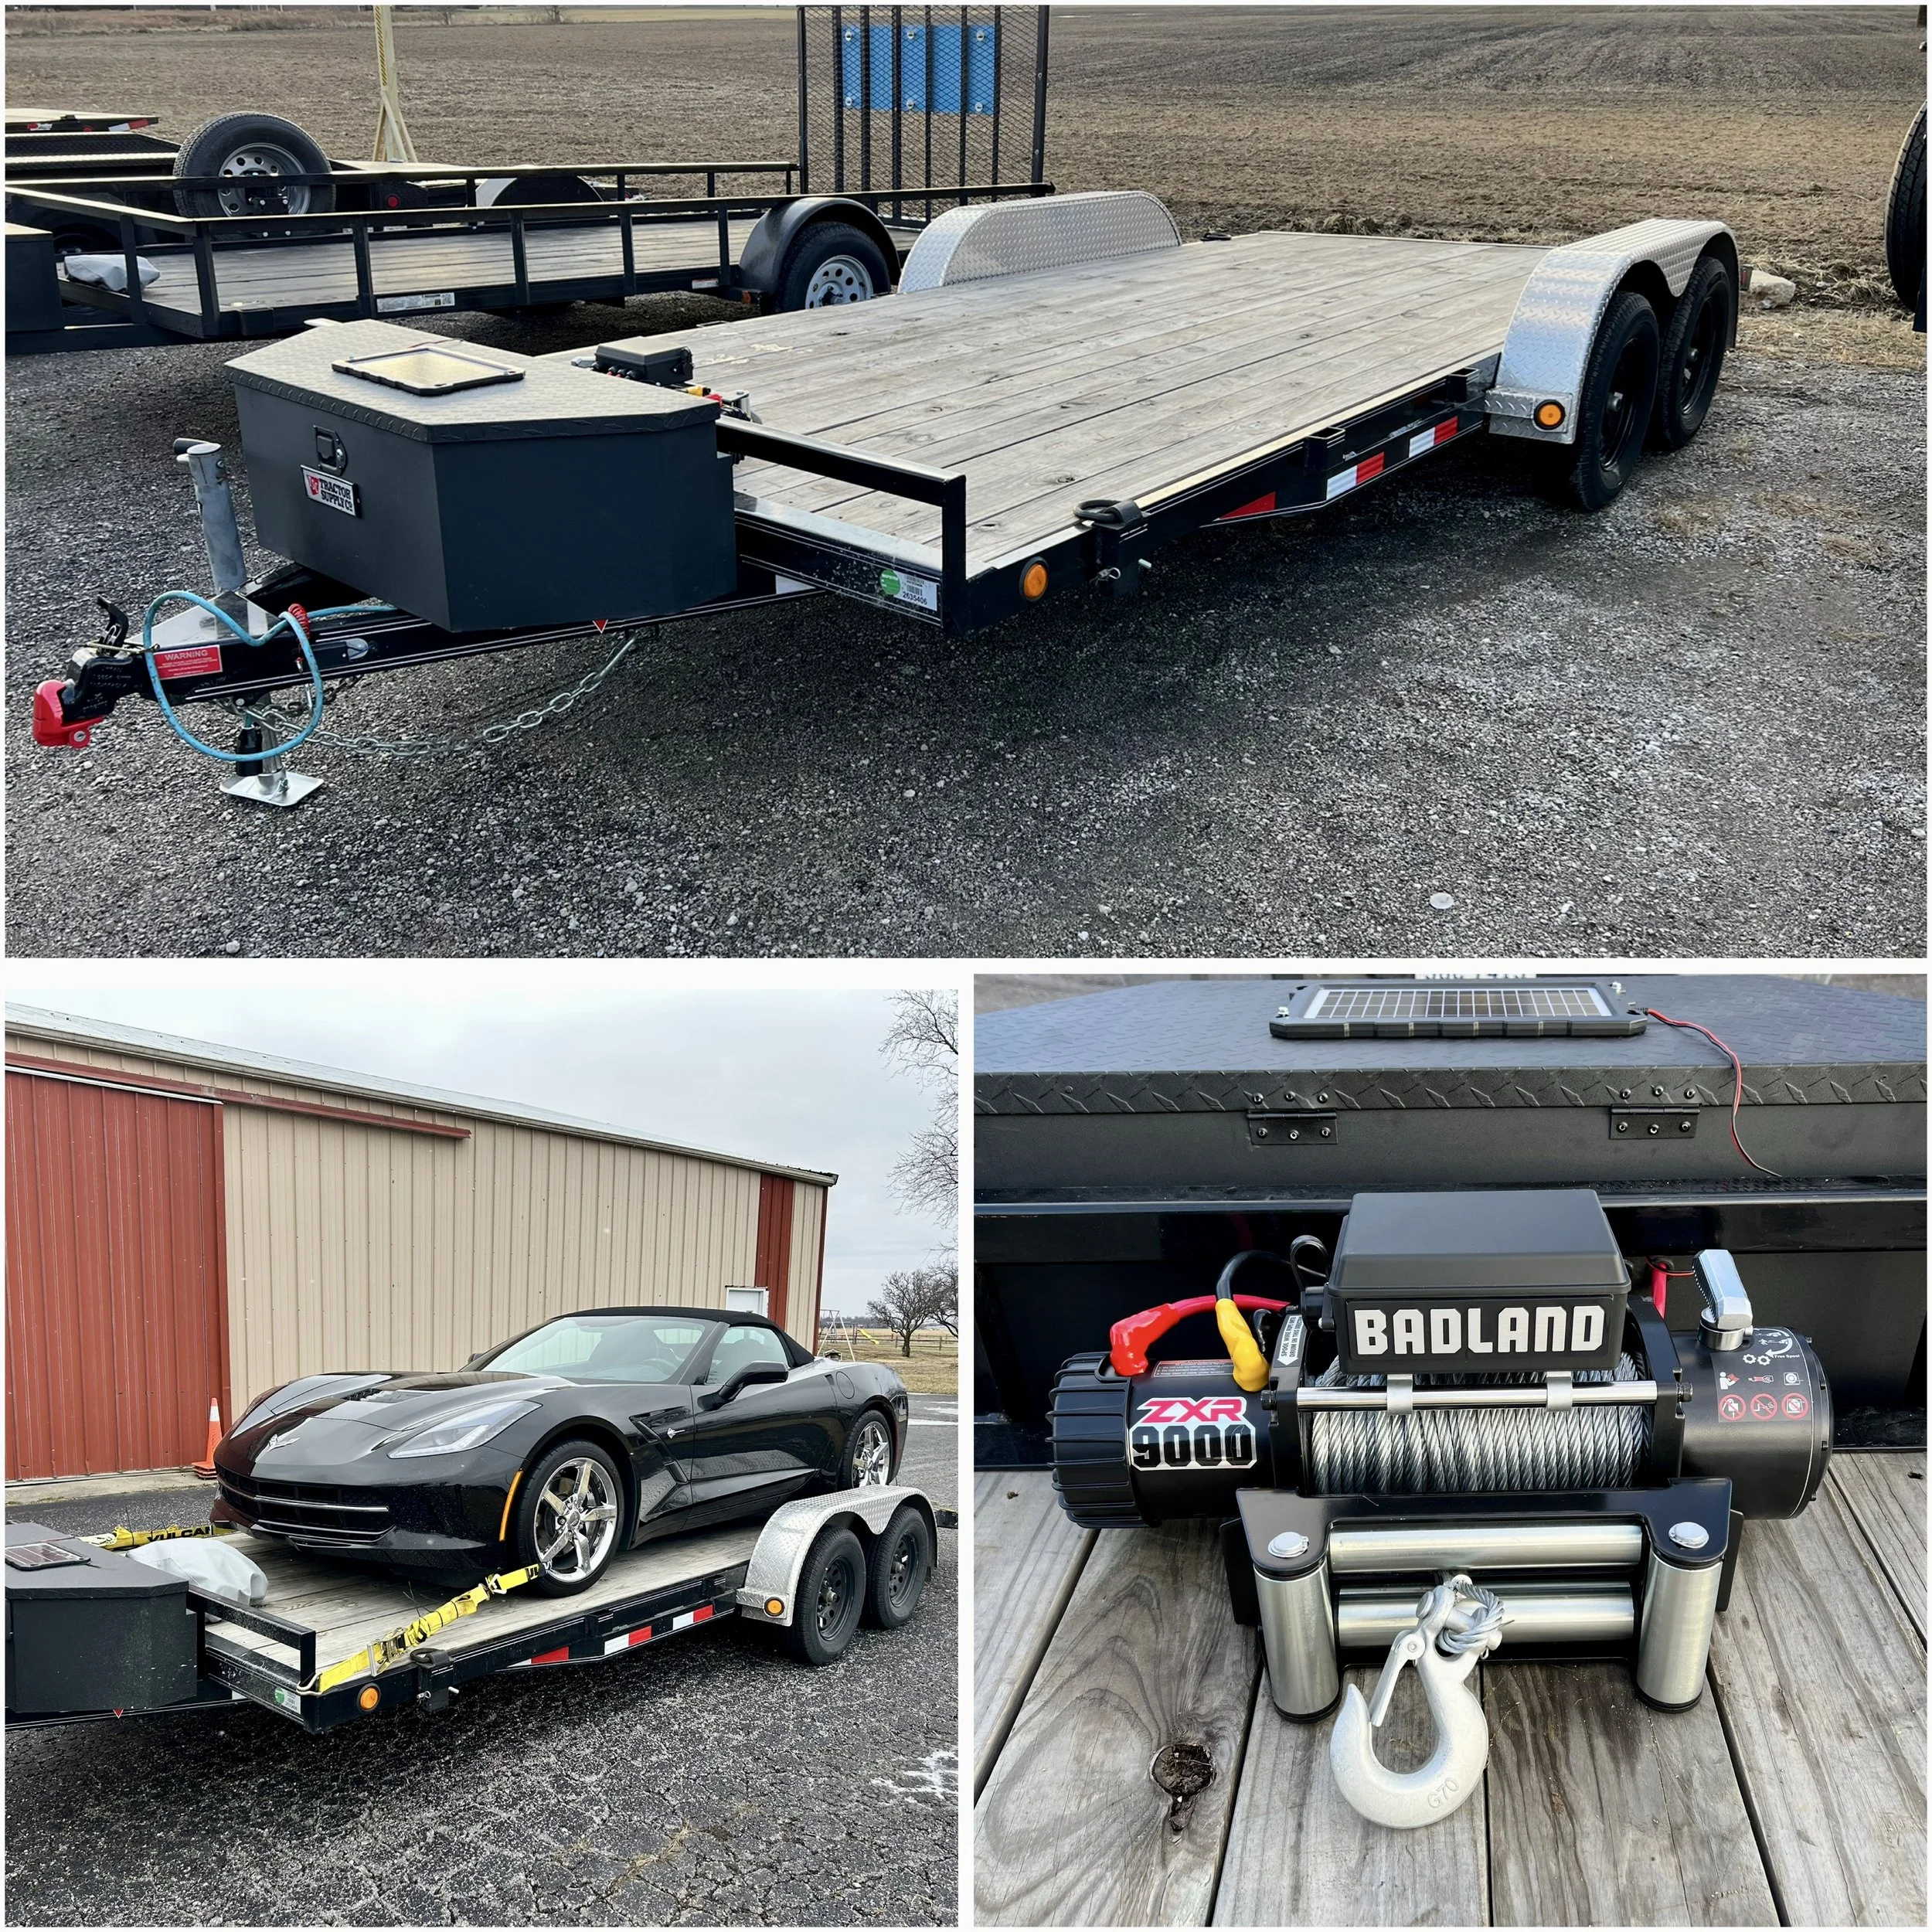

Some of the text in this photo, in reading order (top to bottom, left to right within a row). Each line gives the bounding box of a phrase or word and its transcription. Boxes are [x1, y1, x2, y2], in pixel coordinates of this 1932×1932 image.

[318, 478, 352, 500] TRACTOR
[321, 489, 345, 509] SUPPLY
[165, 649, 209, 661] WARNING
[1354, 1305, 1605, 1355] BADLAND
[1140, 1399, 1243, 1423] ZXR
[1131, 1424, 1253, 1468] 9000
[1427, 1777, 1460, 1809] G70
